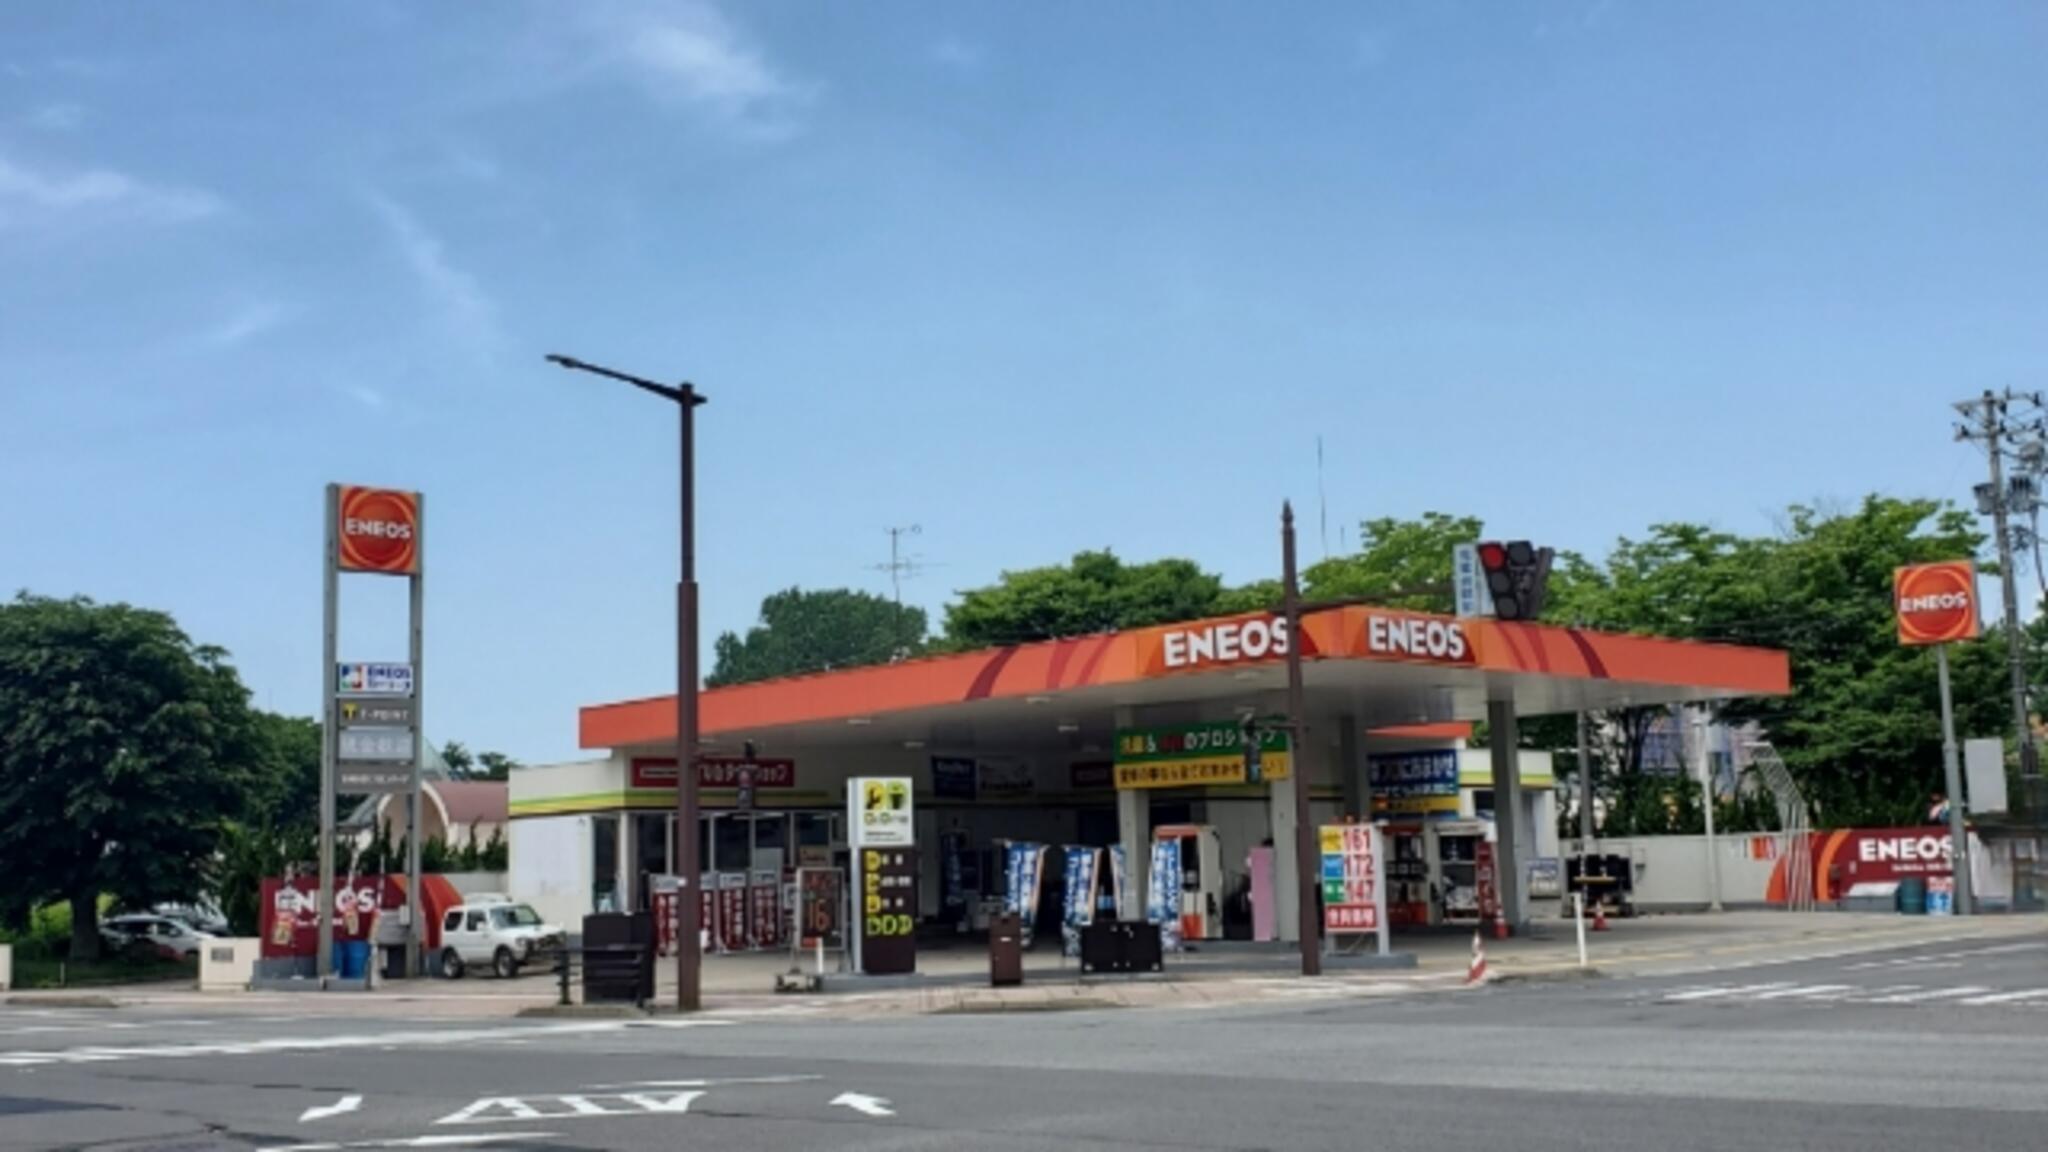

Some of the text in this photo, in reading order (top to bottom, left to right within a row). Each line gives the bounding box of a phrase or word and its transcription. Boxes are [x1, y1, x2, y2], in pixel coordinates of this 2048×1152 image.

[344, 517, 412, 539] ENEOS
[1900, 591, 1967, 613] ENEOS
[1164, 616, 1288, 667] ENEOS
[1368, 616, 1465, 659] ENEOS
[1859, 835, 1953, 861] ENEOS
[1345, 854, 1374, 877] 172
[274, 886, 376, 914] ENOS
